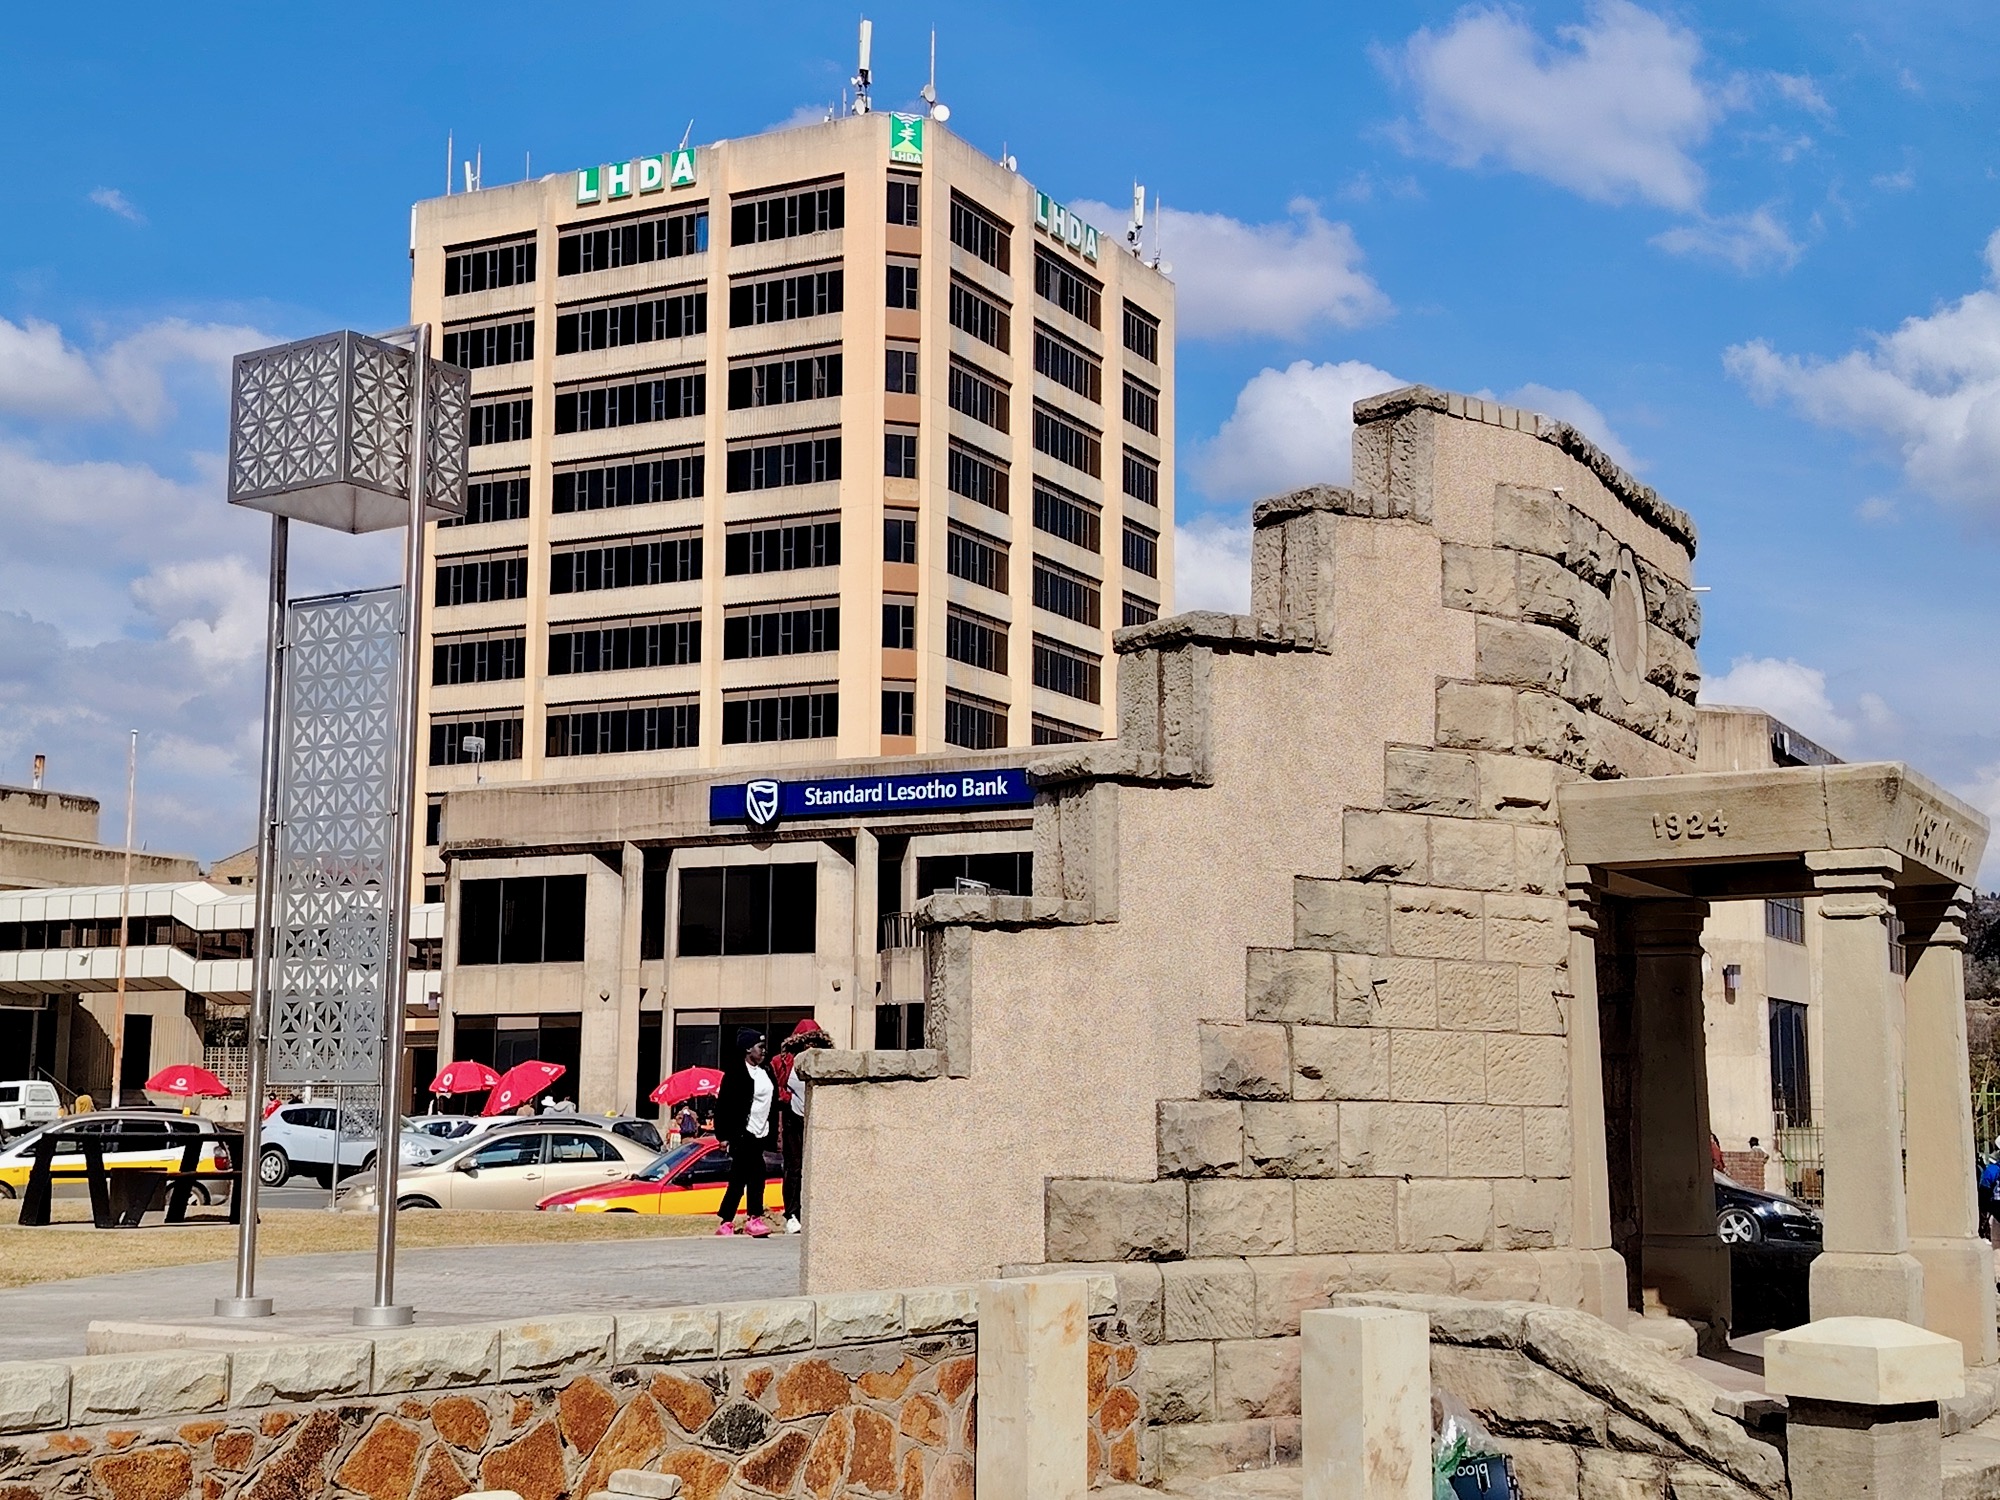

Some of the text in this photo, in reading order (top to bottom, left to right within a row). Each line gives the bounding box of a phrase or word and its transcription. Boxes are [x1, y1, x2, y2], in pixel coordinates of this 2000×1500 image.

[891, 150, 922, 164] LHDA
[578, 152, 695, 201] LHDA
[1036, 192, 1098, 260] LHDA
[804, 775, 1008, 806] Standard Lesotho Bank
[1652, 809, 1729, 841] 1924
